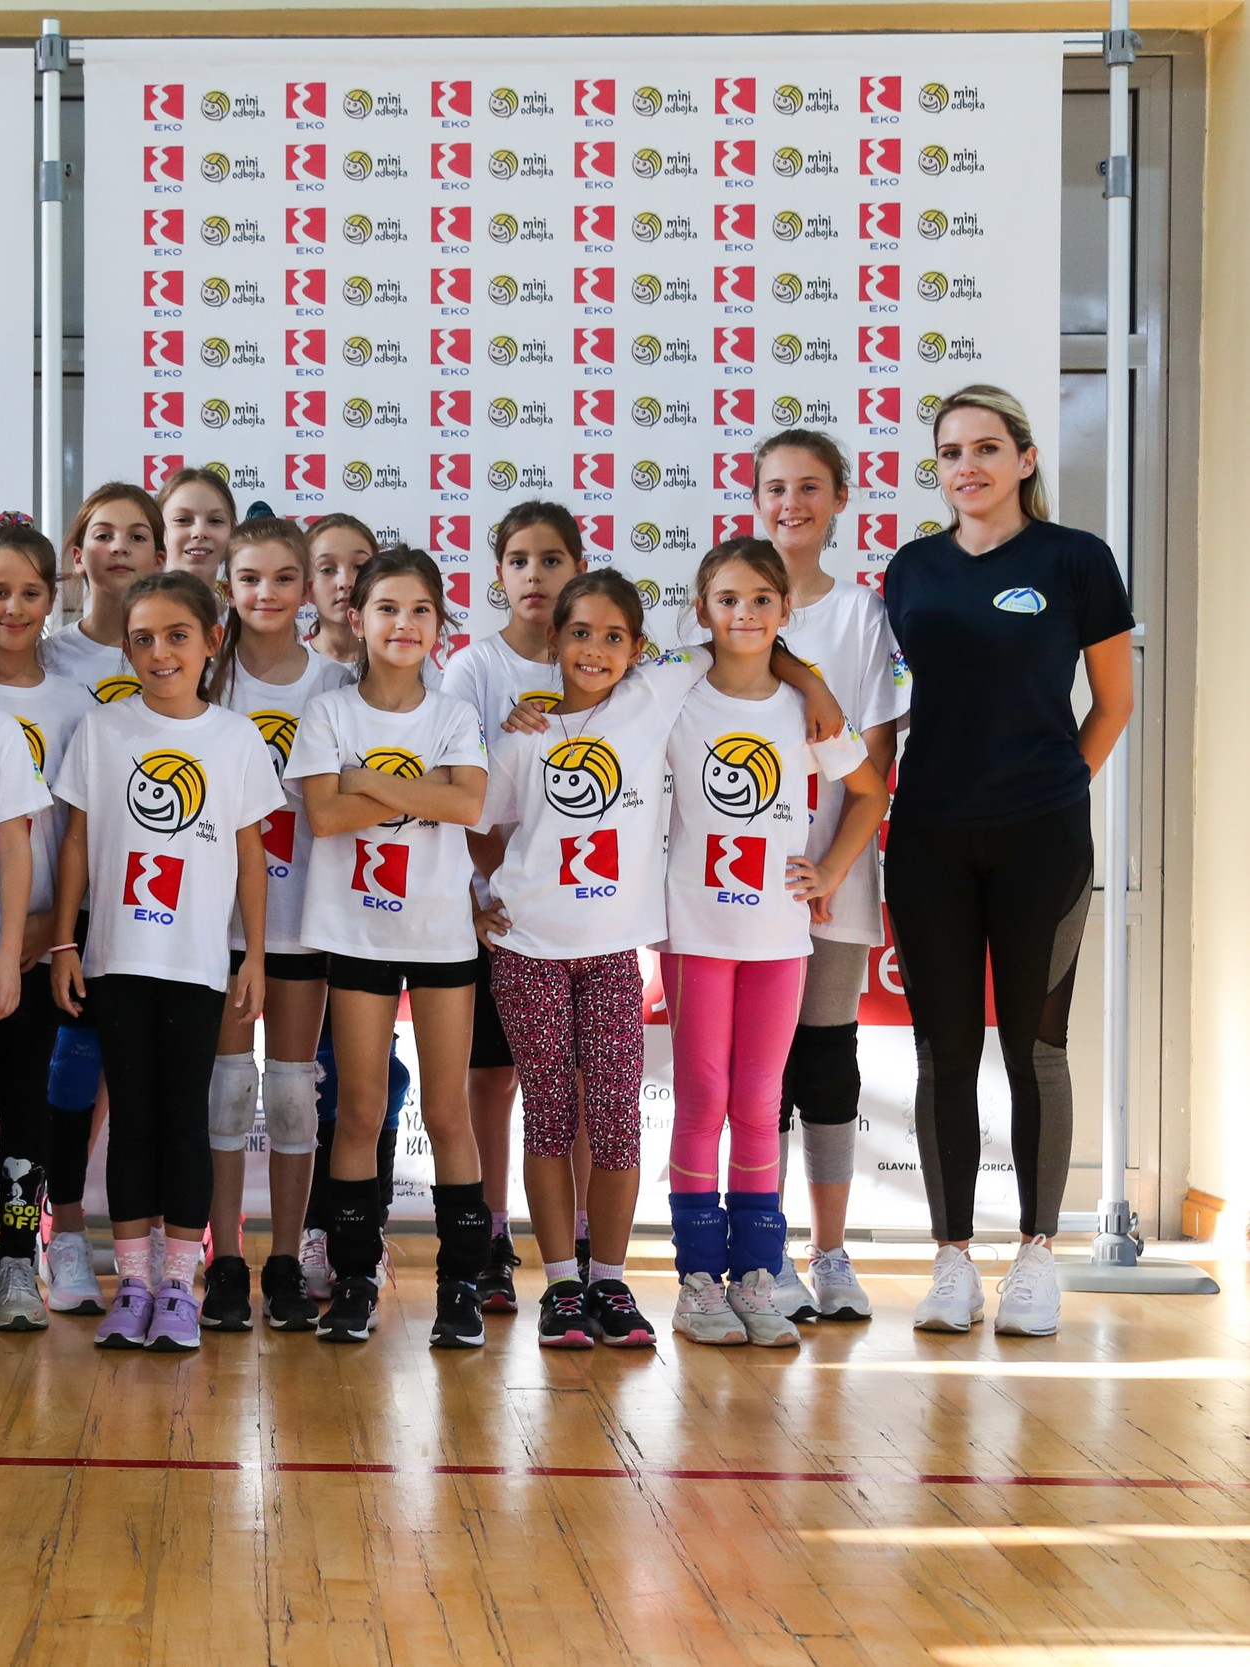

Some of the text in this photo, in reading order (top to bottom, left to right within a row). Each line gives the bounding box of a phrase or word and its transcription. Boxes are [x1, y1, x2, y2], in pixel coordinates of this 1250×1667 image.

[235, 94, 258, 107] mini
[524, 91, 546, 104] mini
[808, 88, 831, 101] mini
[233, 107, 265, 119] odbojka
[521, 104, 553, 116] odbojka
[806, 101, 839, 113] odbojka
[442, 120, 471, 128] EKO
[378, 154, 400, 167] mini
[667, 152, 690, 164] mini
[954, 149, 977, 161] mini
[375, 167, 407, 179] odbojka
[664, 164, 697, 177] odbojka
[951, 161, 984, 174] odbojka
[296, 183, 325, 191] EKO
[585, 181, 614, 189] EKO
[870, 178, 900, 186] EKO
[235, 219, 258, 232] mini
[523, 217, 546, 229] mini
[808, 214, 831, 227] mini
[233, 232, 265, 244] odbojka
[521, 229, 553, 242] odbojka
[805, 227, 838, 240] odbojka
[154, 248, 183, 256] EKO
[377, 279, 400, 292] mini
[667, 278, 689, 290] mini
[953, 274, 975, 287] mini
[375, 292, 407, 304] odbojka
[664, 290, 697, 303] odbojka
[950, 287, 981, 300] odbojka
[296, 308, 325, 316] EKO
[235, 341, 257, 353] mini
[523, 339, 545, 351] mini
[807, 338, 830, 350] mini
[232, 353, 265, 365] odbojka
[520, 351, 553, 364] odbojka
[804, 350, 837, 363] odbojka
[377, 401, 400, 414] mini
[667, 400, 689, 413] mini
[375, 414, 407, 426] odbojka
[664, 413, 696, 425] odbojka
[523, 465, 545, 477] mini
[520, 477, 552, 489] odbojka
[869, 491, 897, 499] EKO
[666, 526, 688, 538] mini
[663, 538, 696, 551] odbojka
[623, 787, 638, 800] mini
[622, 796, 644, 808] odbojka
[775, 801, 791, 813] mini
[198, 820, 215, 833] mini
[195, 829, 217, 842] odbojka
[266, 865, 289, 878] KO
[575, 885, 616, 899] EKO
[363, 895, 403, 912] EKO
[717, 891, 759, 906] EKO
[134, 908, 174, 925] EKO
[877, 1162, 917, 1171] GLAVNI
[3, 1213, 39, 1231] OFF
